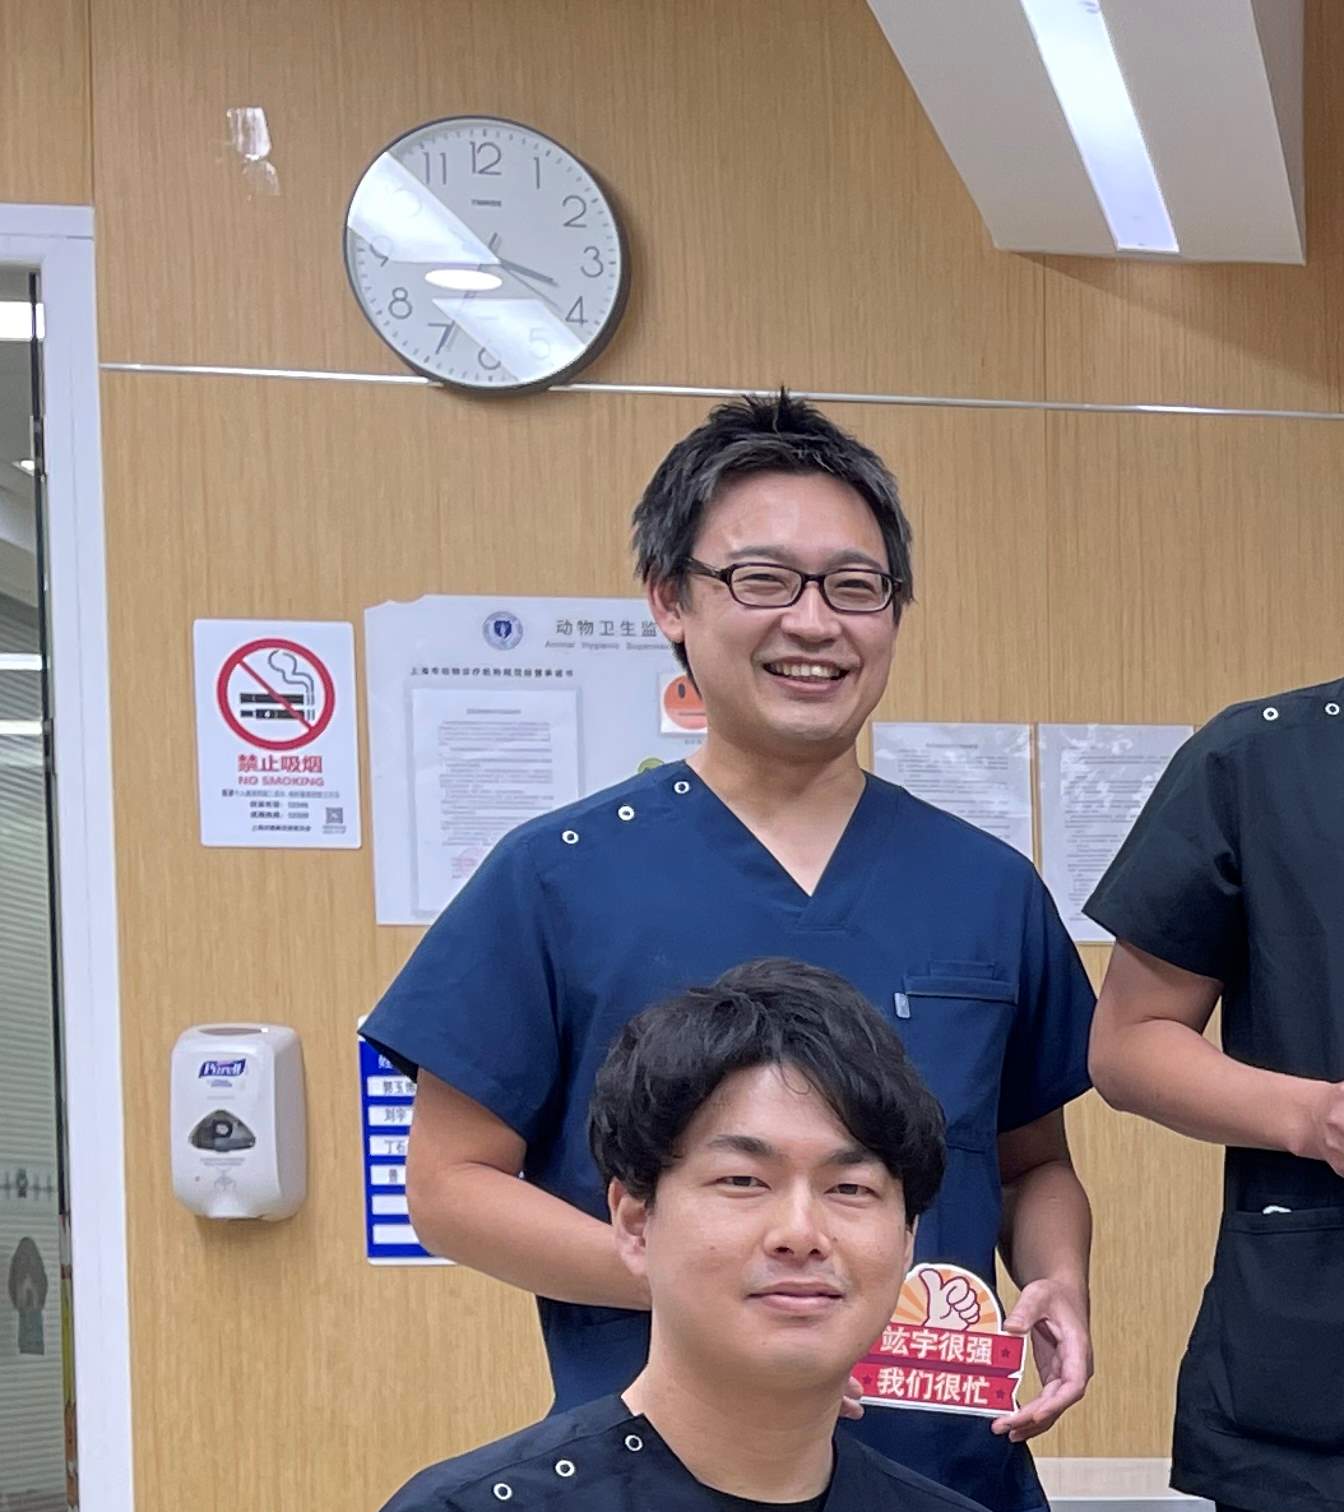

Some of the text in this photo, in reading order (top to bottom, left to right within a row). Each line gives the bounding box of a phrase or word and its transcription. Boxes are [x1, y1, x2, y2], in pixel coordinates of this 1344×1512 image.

[423, 151, 448, 185] 11
[470, 141, 502, 175] 12
[533, 156, 541, 190] 1
[562, 195, 588, 228] 2
[580, 245, 605, 279] 3
[388, 286, 413, 320] 8
[565, 295, 589, 327] 4
[427, 321, 456, 355] 7
[237, 754, 323, 774] 禁止吸烟
[238, 775, 325, 787] NO SMOKING
[876, 1367, 991, 1406] 我们很忙
